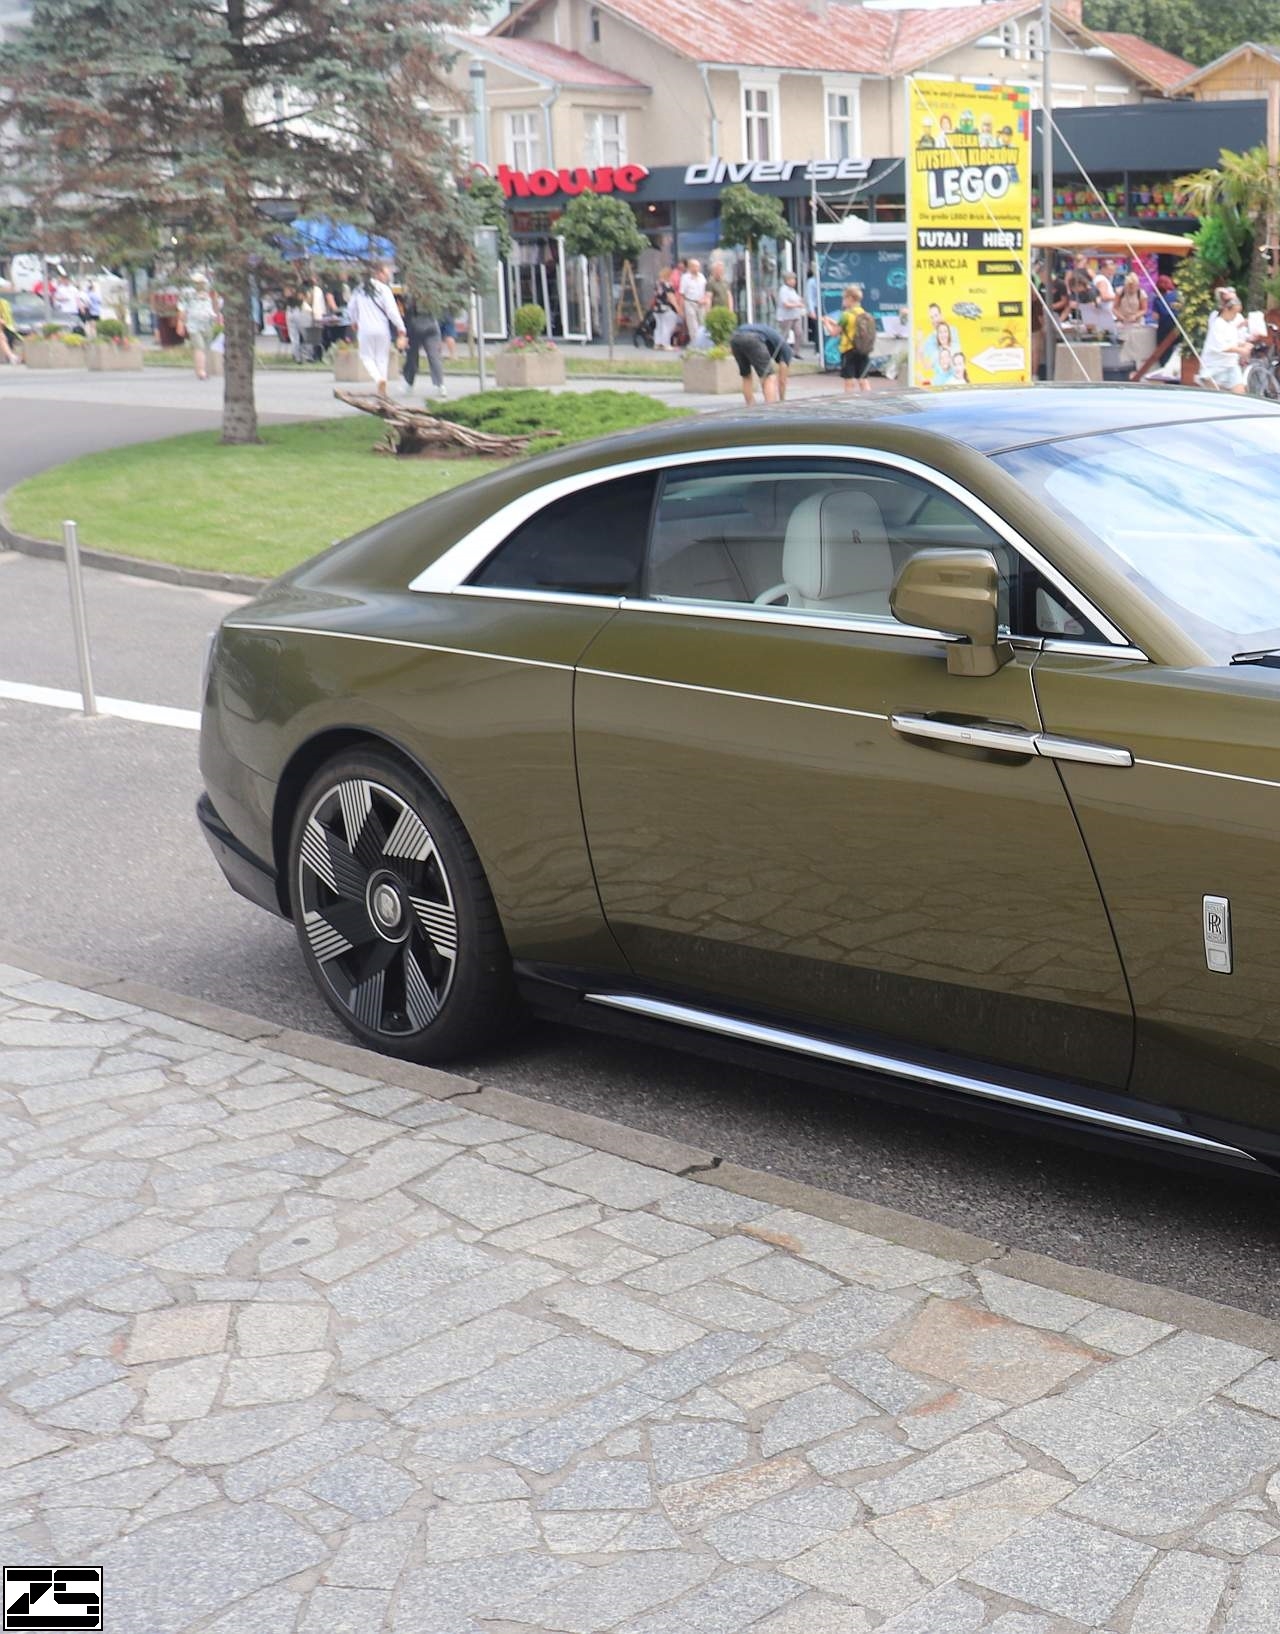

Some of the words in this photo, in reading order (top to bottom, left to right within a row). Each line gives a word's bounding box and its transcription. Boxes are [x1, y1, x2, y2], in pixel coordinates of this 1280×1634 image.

[497, 163, 650, 199] house
[684, 155, 873, 185] diverse
[928, 165, 1010, 210] LEGO
[916, 259, 968, 269] ATRAKCJA
[928, 275, 935, 285] 4
[937, 275, 947, 286] W
[950, 275, 955, 285] 1
[1208, 911, 1222, 936] RR
